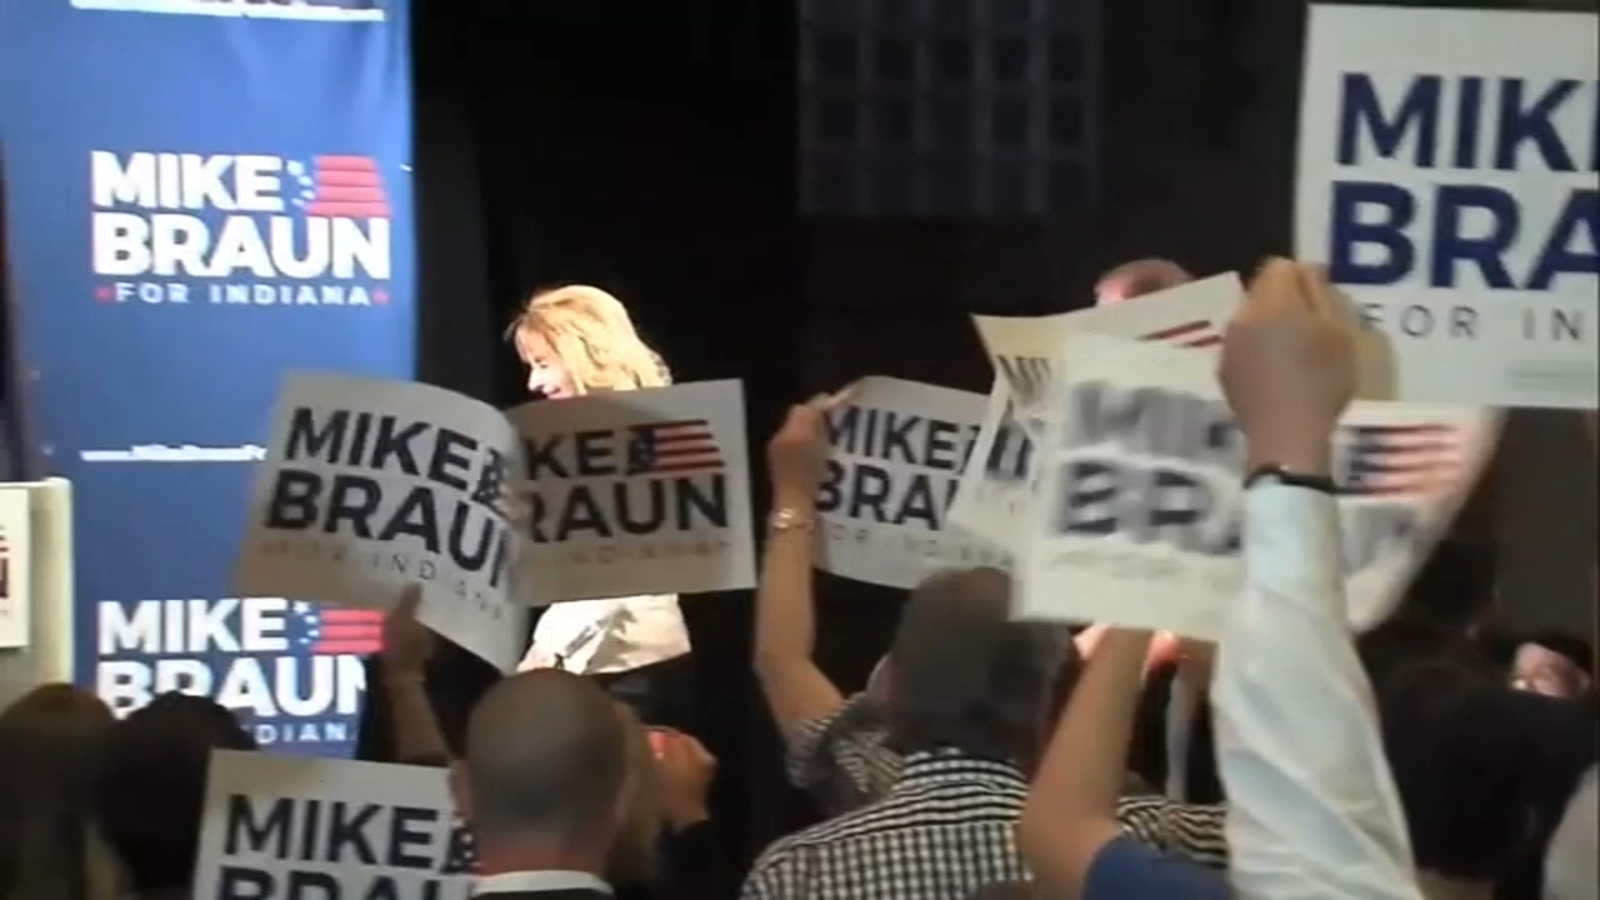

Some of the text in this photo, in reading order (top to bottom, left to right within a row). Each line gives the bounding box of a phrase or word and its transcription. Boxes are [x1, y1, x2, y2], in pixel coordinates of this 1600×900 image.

[1336, 71, 1598, 171] MIK
[91, 150, 284, 211] MIKE
[91, 211, 391, 280] BRAUN
[115, 282, 371, 306] FOR INDIANA
[285, 406, 479, 492] MIKE
[522, 429, 617, 481] KE
[532, 473, 728, 543] AUN
[815, 459, 959, 531] BRA
[97, 597, 289, 655] MIKE
[224, 793, 440, 869] MIKE
